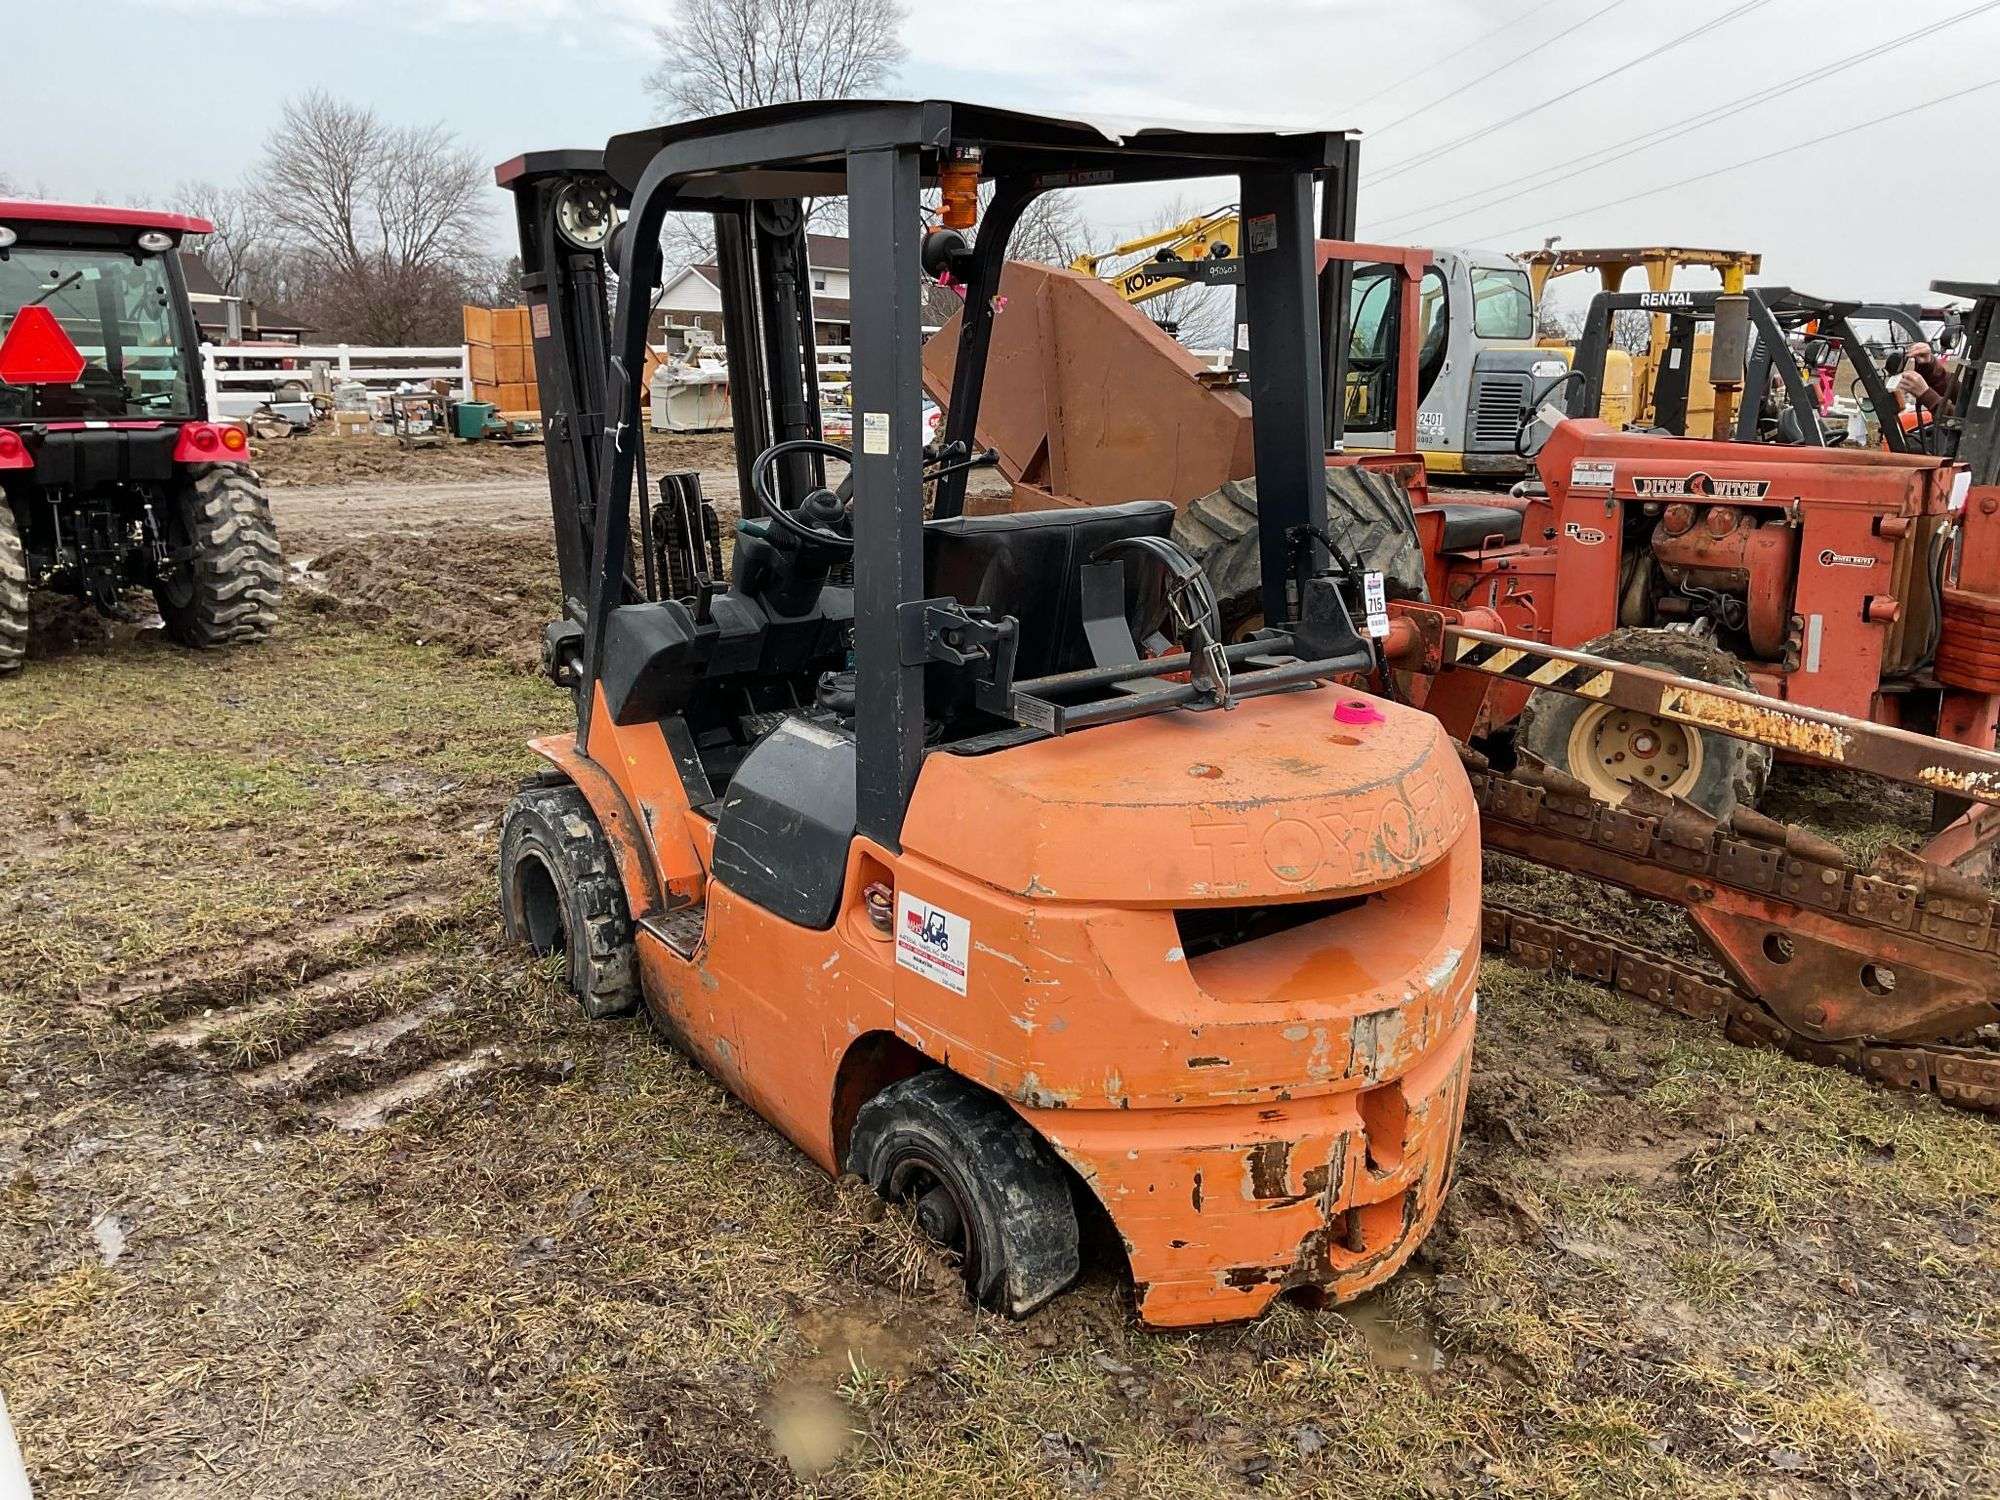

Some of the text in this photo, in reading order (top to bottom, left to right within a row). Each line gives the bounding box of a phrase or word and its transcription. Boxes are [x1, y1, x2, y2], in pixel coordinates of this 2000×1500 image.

[1640, 292, 1694, 306] RENTAL
[1642, 479, 1760, 497] DITCH WITCH
[1368, 597, 1383, 612] 715
